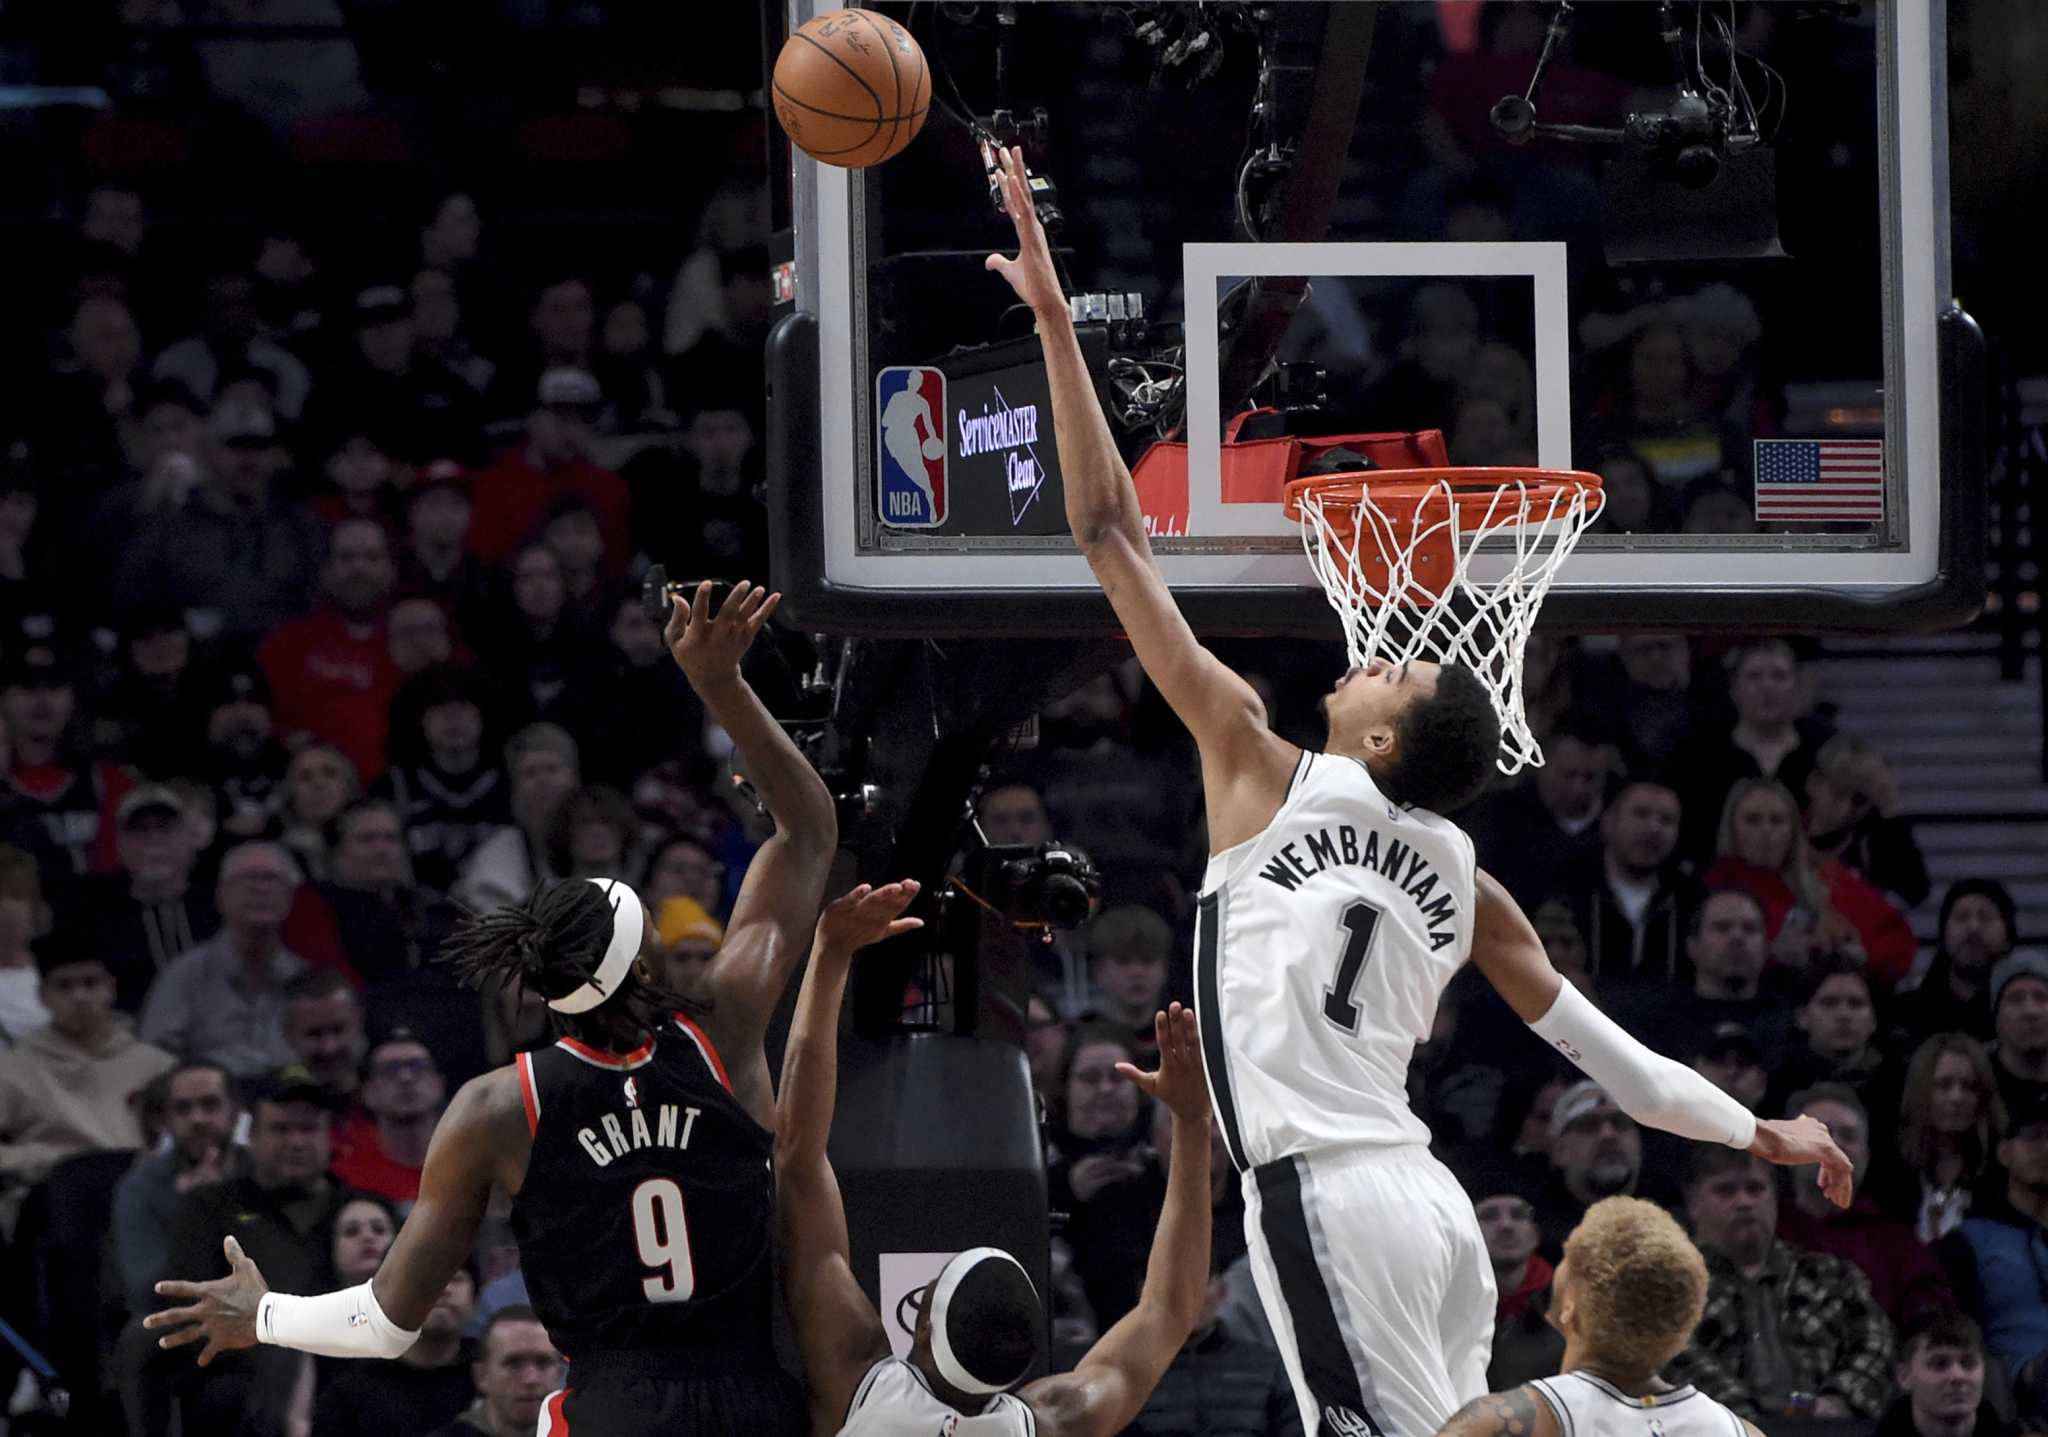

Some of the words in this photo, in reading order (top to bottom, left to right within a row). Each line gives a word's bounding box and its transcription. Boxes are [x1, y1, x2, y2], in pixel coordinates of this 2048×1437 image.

[889, 491, 922, 517] NBA
[1008, 451, 1036, 492] Clean
[1258, 824, 1456, 953] WEMBANYAMA
[1321, 896, 1387, 1039] 1
[577, 1103, 702, 1167] GRANT
[631, 1176, 695, 1304] 9
